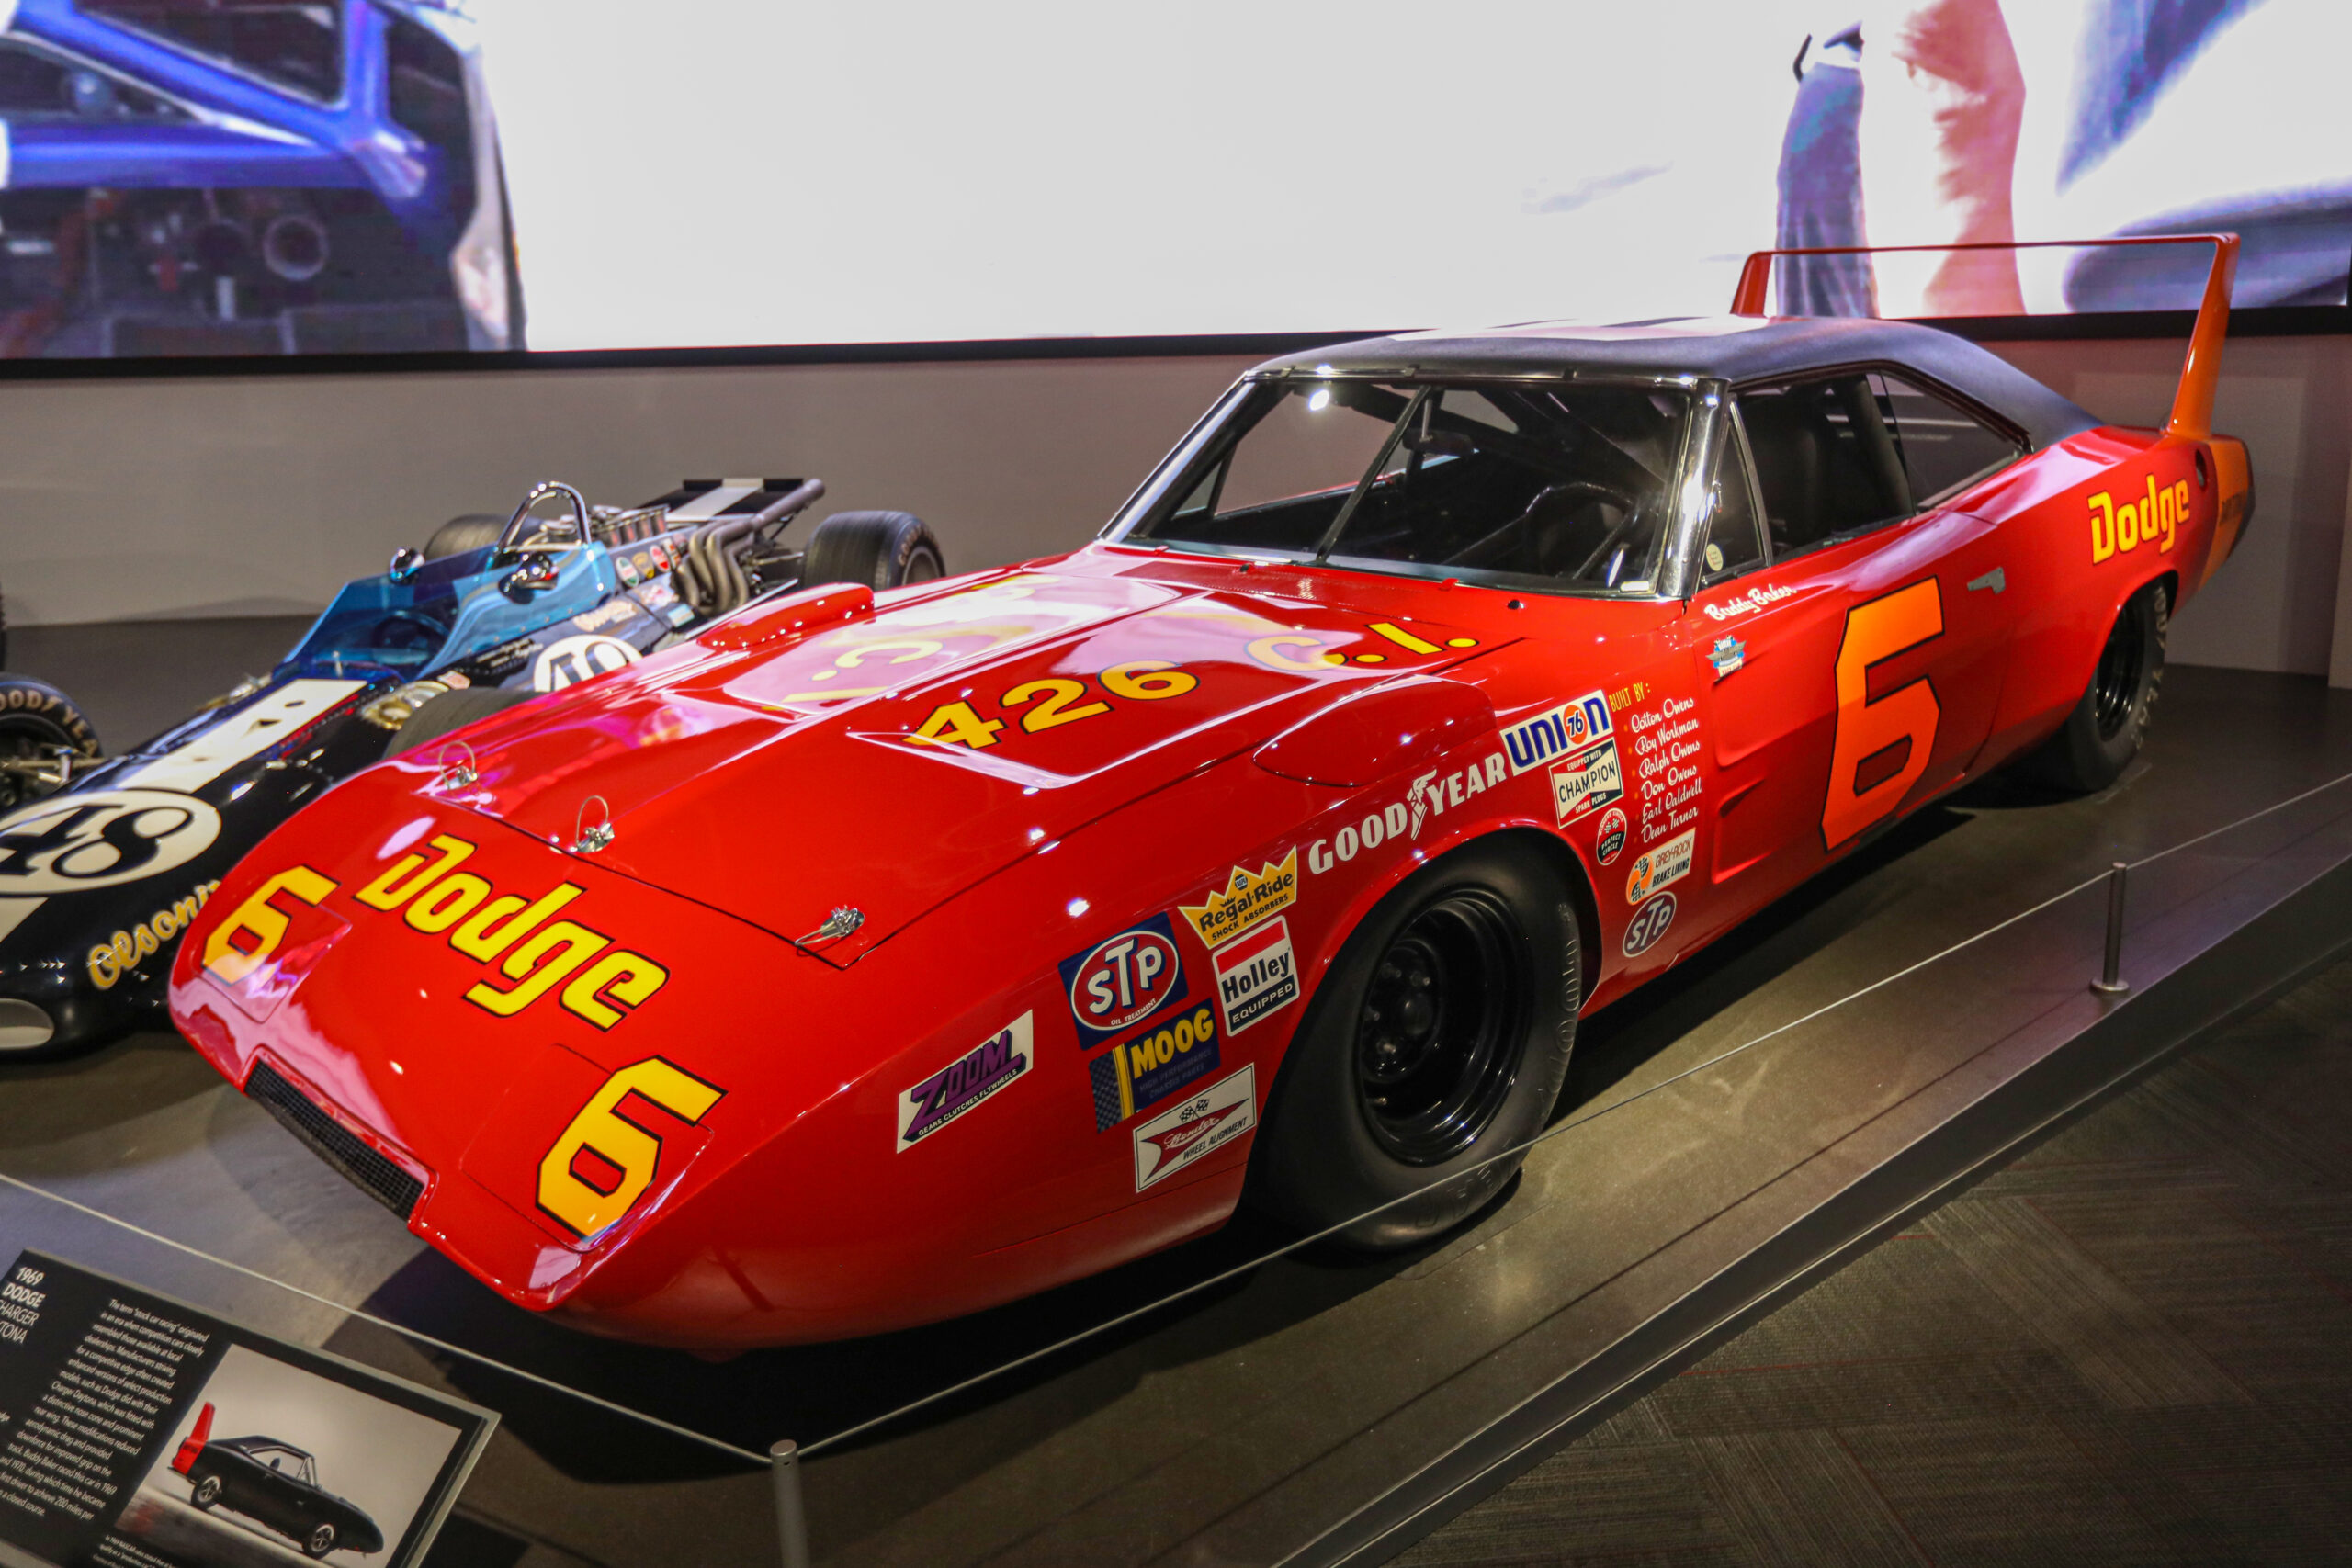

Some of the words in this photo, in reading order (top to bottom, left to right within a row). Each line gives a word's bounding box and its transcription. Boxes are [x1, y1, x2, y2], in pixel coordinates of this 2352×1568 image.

[2087, 472, 2190, 566] Dodge
[1703, 597, 1761, 621] Buddy
[1747, 583, 1798, 605] Baker
[899, 660, 1202, 750] 426
[1609, 687, 1631, 712] BUILT
[1631, 712, 1662, 733] Cotton
[1663, 697, 1694, 718] Owens
[1819, 575, 1945, 854] 6
[1505, 696, 1610, 768] UNION
[1566, 711, 1585, 738] 76
[1634, 735, 1657, 756] Roy
[1657, 717, 1699, 748] Workman
[1566, 756, 1590, 772] EQUIPPED
[1589, 749, 1602, 763] WITH
[1639, 750, 1670, 779] Ralph
[1670, 740, 1700, 762] Owens
[1558, 761, 1616, 803] CHAMPION
[1575, 800, 1591, 814] SPARK
[1591, 792, 1607, 807] PLUGS
[1641, 780, 1665, 801] Don
[1668, 765, 1697, 786] Owens
[1642, 798, 1662, 825] Earl
[1665, 776, 1702, 811] Caldwell
[1601, 832, 1622, 851] PERFECT
[1641, 823, 1668, 844] Dean
[1668, 806, 1699, 830] Turner
[1602, 841, 1619, 856] CIRCLE
[1652, 866, 1670, 887] BRAKE
[1670, 857, 1690, 879] LINING
[199, 864, 342, 987] 6
[351, 832, 671, 1033] Dodge
[1212, 921, 1239, 941] SHOCK
[1243, 894, 1289, 924] ABSORBERS
[1626, 897, 1672, 951] STP
[1087, 938, 1167, 1016] STP
[1221, 952, 1290, 1004] Holley
[1124, 998, 1157, 1023] TREATMENT
[1232, 982, 1294, 1024] EQUIPPED
[1130, 1008, 1214, 1079] MOOG
[902, 1020, 1027, 1144] ZOOM
[919, 1117, 942, 1136] GEARS
[944, 1095, 978, 1121] CLUTCHES
[979, 1068, 1017, 1098] FLYWHEELS
[535, 1055, 729, 1242] 6
[1183, 1141, 1206, 1160] WHEEL
[1208, 1116, 1248, 1147] ALIGNMENT
[2, 1283, 45, 1307] DODGE
[17, 1268, 43, 1285] 1969
[110, 1299, 120, 1309] The
[119, 1304, 133, 1314] term
[178, 1327, 209, 1342] originated
[124, 1321, 140, 1330] when
[139, 1327, 172, 1343] competition
[171, 1339, 184, 1348] cars
[184, 1343, 204, 1357] closely
[93, 1325, 123, 1338] resembled
[121, 1334, 137, 1345] those
[136, 1341, 161, 1354] available
[167, 1350, 183, 1361] local
[117, 1346, 155, 1367] Manufacturers
[154, 1363, 176, 1377] striving
[68, 1359, 96, 1373] enhanced
[95, 1370, 118, 1382] versions
[123, 1381, 141, 1392] select
[139, 1388, 172, 1404] production
[76, 1345, 86, 1354] for
[89, 1352, 120, 1369] competitive
[120, 1365, 136, 1375] edge
[135, 1370, 152, 1380] often
[151, 1377, 175, 1389] created
[48, 1395, 74, 1412] distinctive
[74, 1408, 88, 1417] nose
[88, 1414, 103, 1423] cone
[102, 1420, 116, 1428] and
[113, 1425, 144, 1440] prominent
[51, 1381, 74, 1395] Charger
[97, 1402, 115, 1412] which
[114, 1409, 126, 1417] was
[126, 1411, 143, 1424] fitted
[141, 1420, 154, 1428] with
[81, 1380, 95, 1388] such
[101, 1385, 121, 1400] Dodge
[121, 1394, 133, 1404] did
[130, 1400, 144, 1408] with
[143, 1404, 158, 1414] their
[17, 1431, 46, 1448] downforce
[45, 1441, 55, 1450] for
[54, 1448, 83, 1463] improved
[79, 1460, 93, 1469] grip
[101, 1467, 111, 1476] the
[60, 1433, 74, 1446] drag
[74, 1440, 86, 1449] and
[84, 1445, 112, 1460] provided
[62, 1416, 78, 1428] These
[77, 1426, 115, 1445] modifications
[114, 1441, 141, 1455] reduced
[23, 1449, 42, 1464] Buddy
[41, 1457, 59, 1469] Baker
[57, 1466, 76, 1477] raced
[74, 1472, 85, 1482] this
[102, 1483, 117, 1495] 1969
[25, 1467, 44, 1483] during
[44, 1477, 61, 1487] which
[60, 1483, 74, 1494] time
[82, 1492, 105, 1507] became
[6, 1494, 28, 1506] closed
[11, 1477, 28, 1489] driver
[33, 1489, 55, 1503] achieve
[54, 1496, 68, 1508] 200
[67, 1505, 83, 1515] miles
[81, 1511, 94, 1519] per
